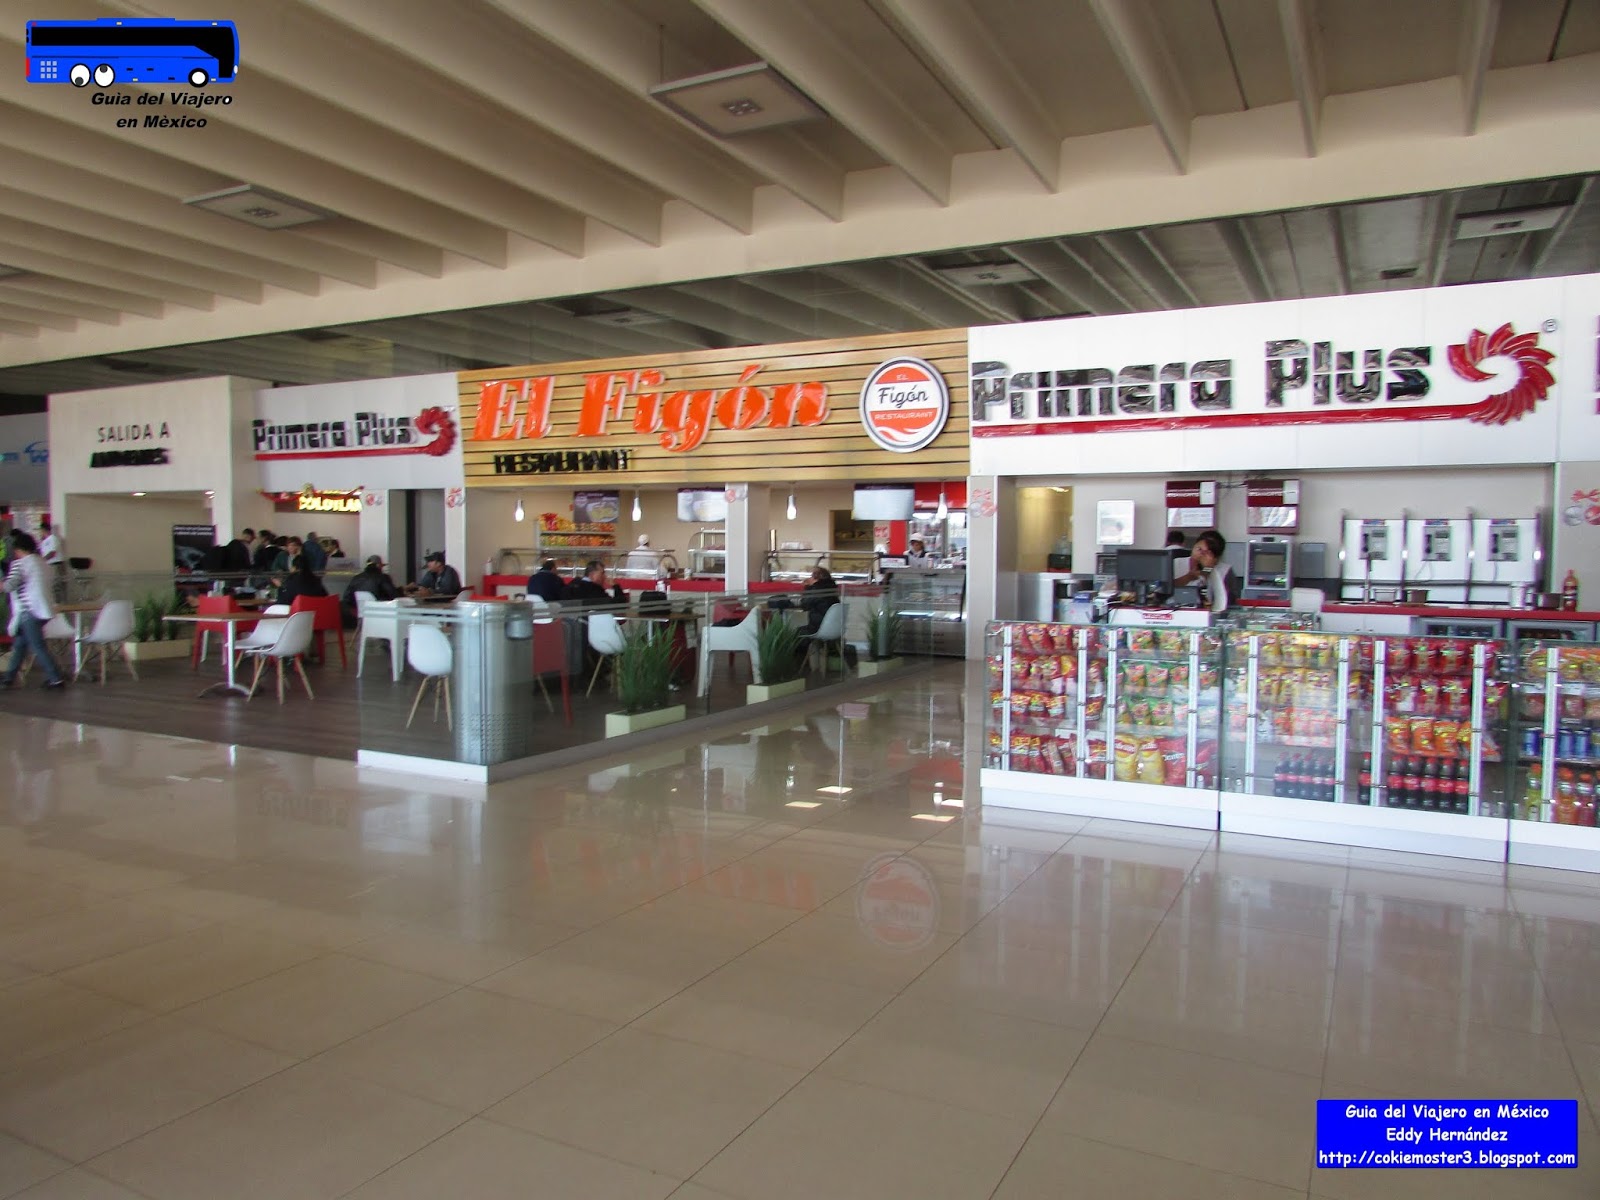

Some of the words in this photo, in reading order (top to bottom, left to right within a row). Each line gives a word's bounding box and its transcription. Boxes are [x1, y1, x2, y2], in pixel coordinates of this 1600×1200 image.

[971, 359, 1232, 421] Primera
[1265, 338, 1431, 408] Plus
[472, 375, 555, 441] El
[574, 364, 830, 453] Figón
[878, 384, 929, 408] Figón
[874, 411, 934, 420] RESTAURANT
[98, 424, 153, 443] SALIDA
[160, 421, 170, 438] A
[252, 419, 347, 450] Primera
[355, 412, 416, 446] Plus
[494, 449, 634, 474] RESTAURANT
